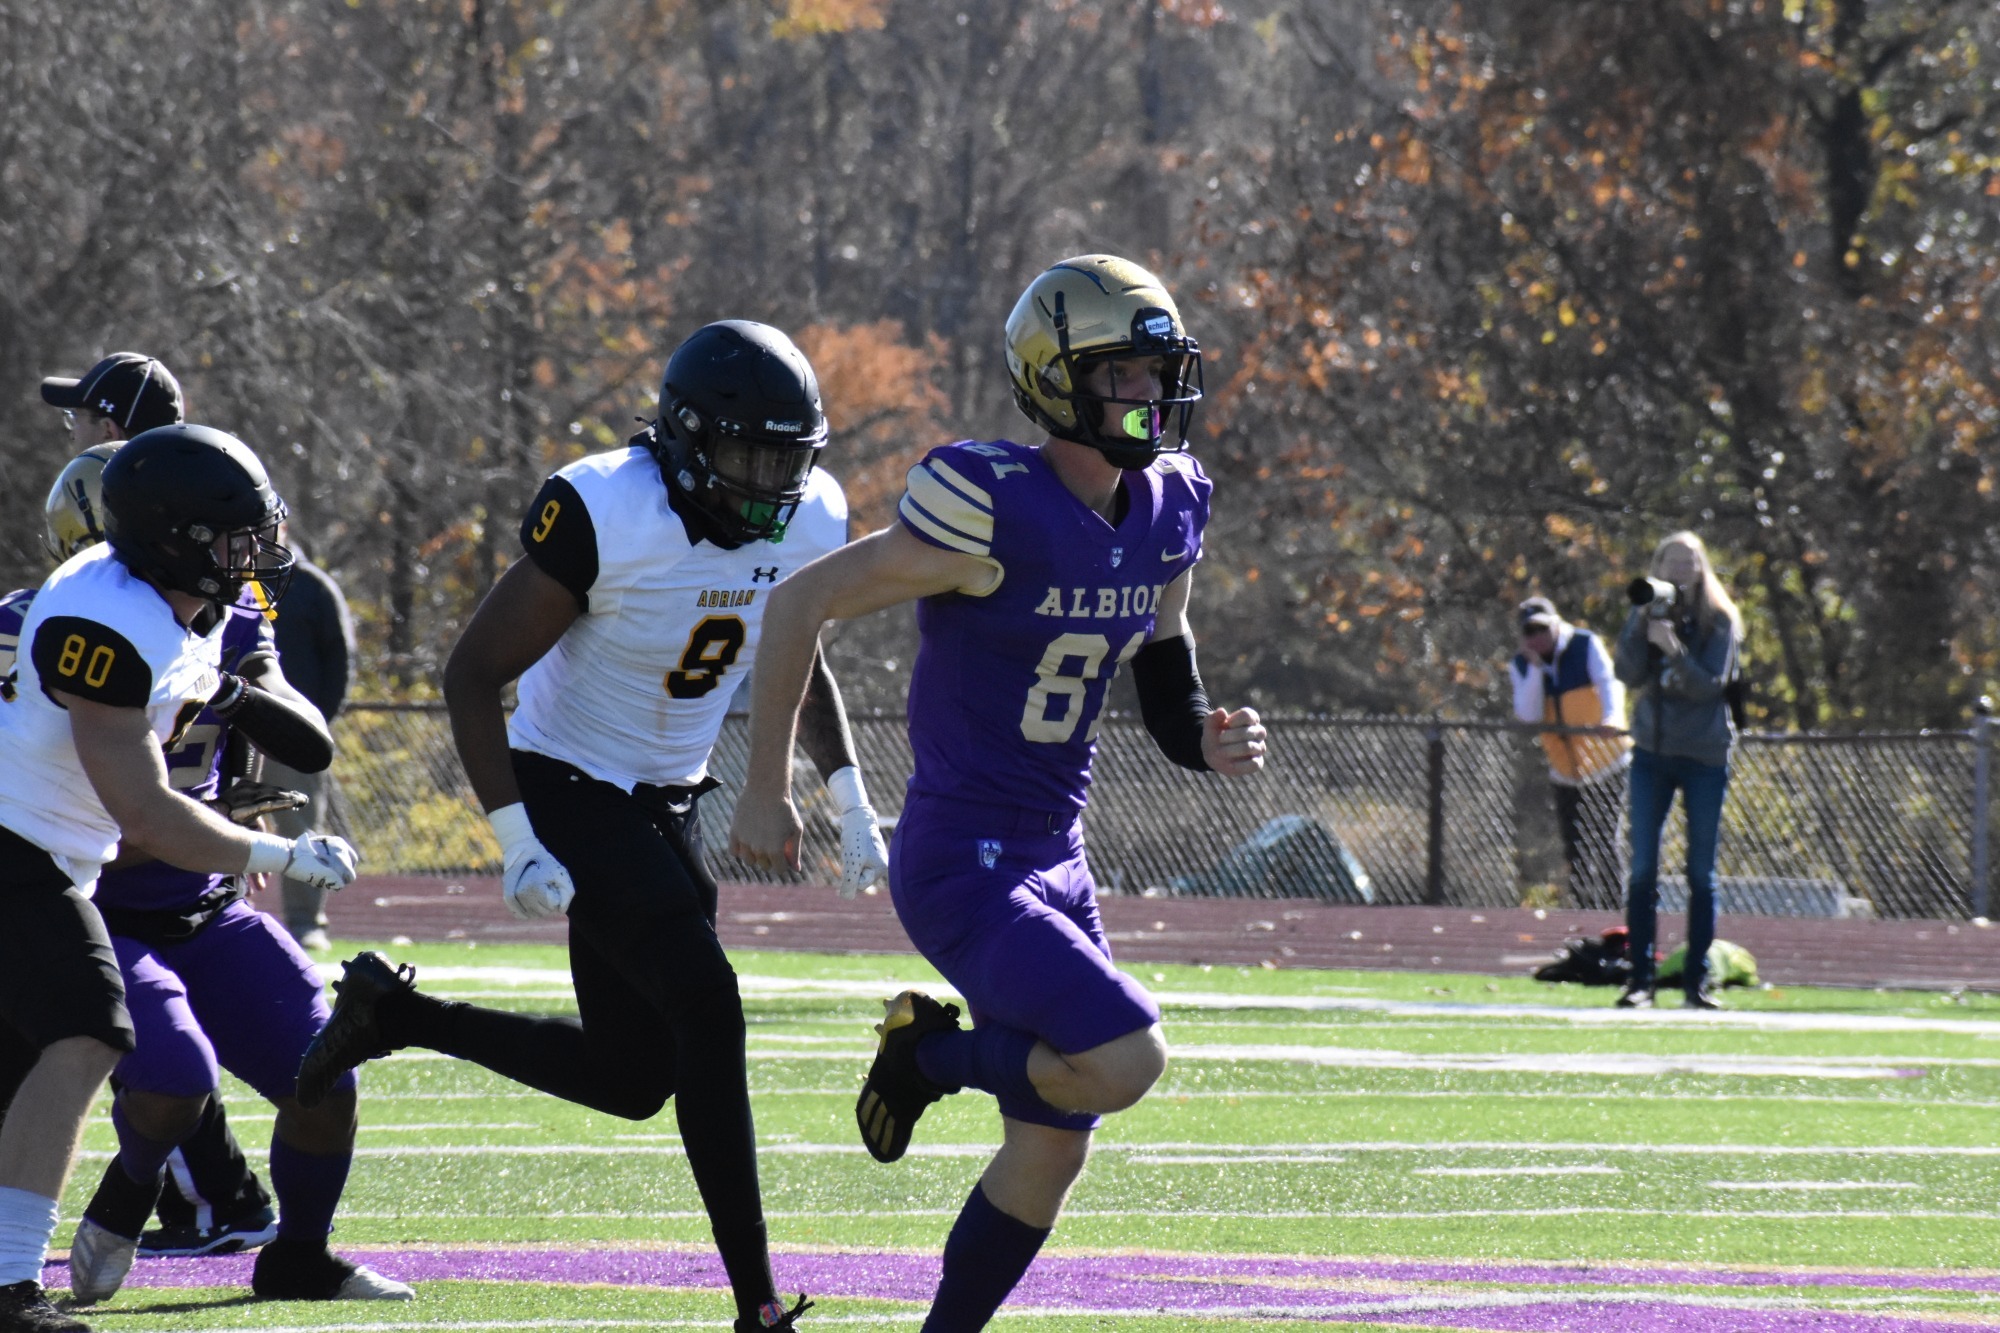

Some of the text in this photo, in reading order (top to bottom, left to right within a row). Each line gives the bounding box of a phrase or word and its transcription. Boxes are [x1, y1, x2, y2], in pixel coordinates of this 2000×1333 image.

[765, 420, 804, 432] Riddell
[962, 444, 1030, 480] 81
[532, 500, 560, 543] 9
[696, 589, 756, 608] ADRIAN
[58, 634, 115, 688] 80
[663, 614, 747, 699] 9
